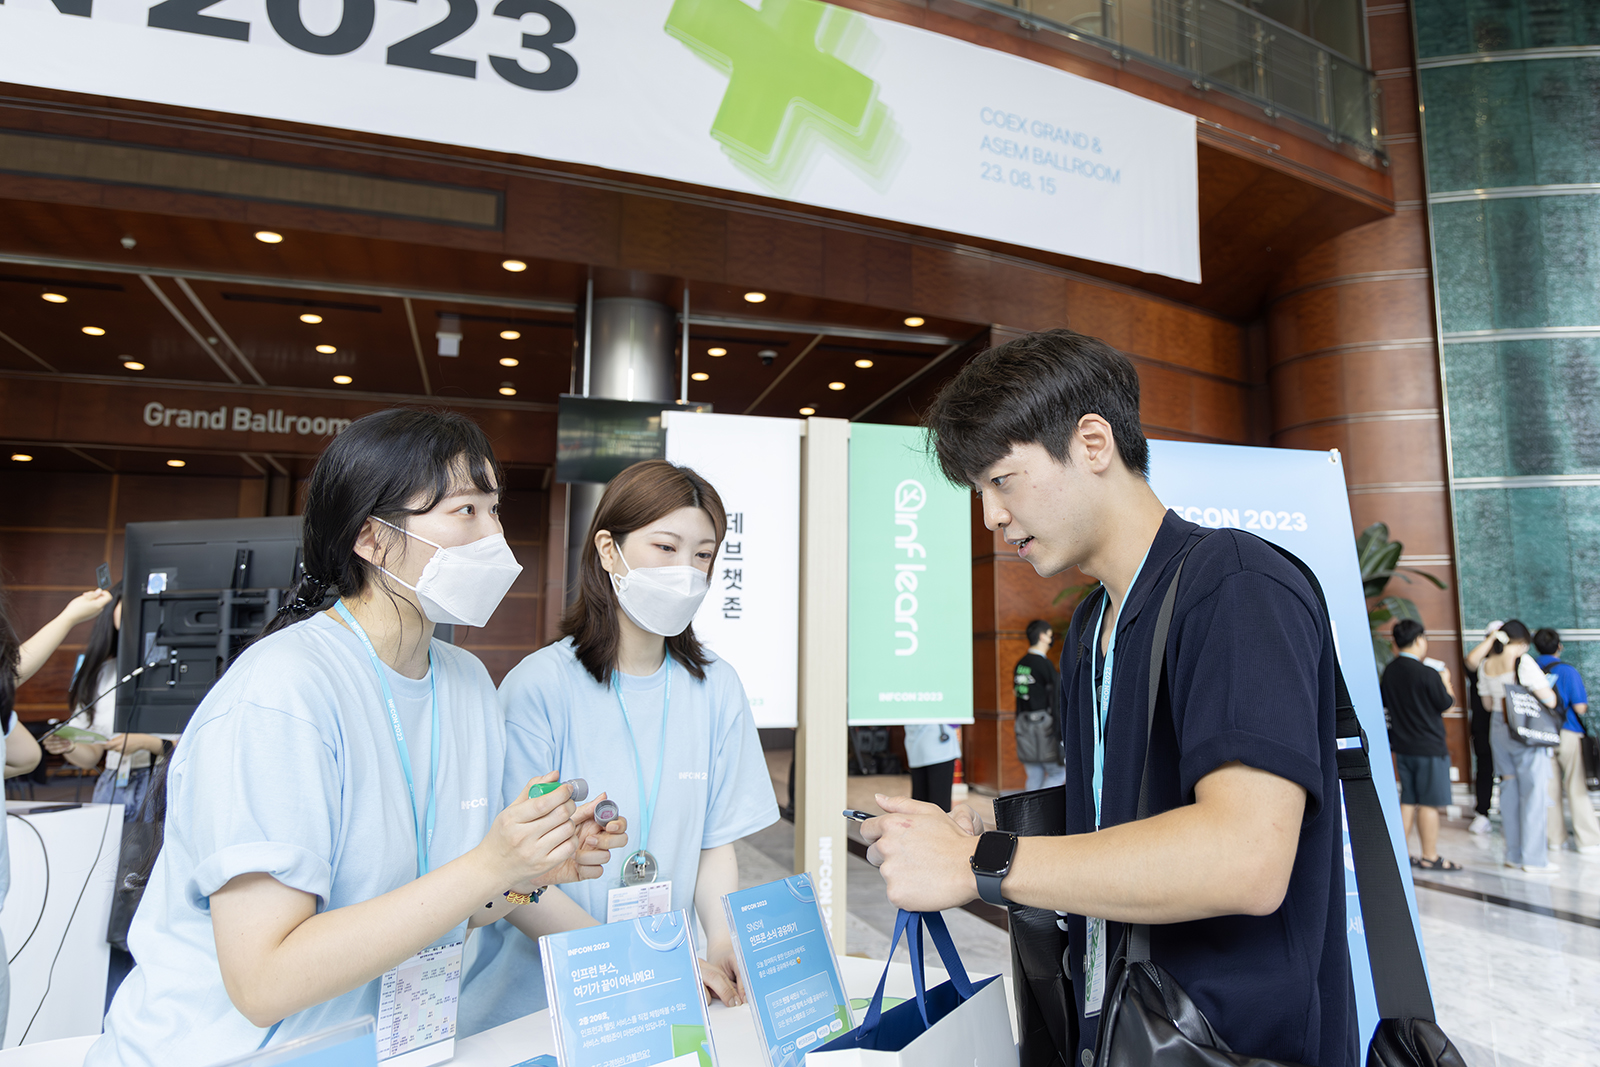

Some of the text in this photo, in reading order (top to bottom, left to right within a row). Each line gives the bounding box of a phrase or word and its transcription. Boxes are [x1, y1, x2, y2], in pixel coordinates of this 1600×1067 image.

[980, 106, 1103, 154] COEX GRAND &
[980, 135, 1121, 184] ASEM BALLROOM
[1039, 175, 1057, 196] 15
[143, 402, 227, 430] Grand
[1244, 509, 1308, 532] 2023
[895, 512, 927, 656] inflearn
[1104, 667, 1112, 685] 2023
[879, 691, 943, 702] INFCON 2023
[387, 698, 403, 741] INFCON 2023
[818, 836, 832, 905] INFCON
[749, 921, 798, 947] 인프콘 소식 공유하기
[567, 941, 611, 957] INFCON 2023
[571, 962, 619, 982] 인프런 부스,
[573, 969, 655, 998] 여기가 끝이 아니에요!
[616, 1015, 637, 1029] 서비스를
[676, 1002, 687, 1012] 있는
[583, 1037, 600, 1049] 서비스
